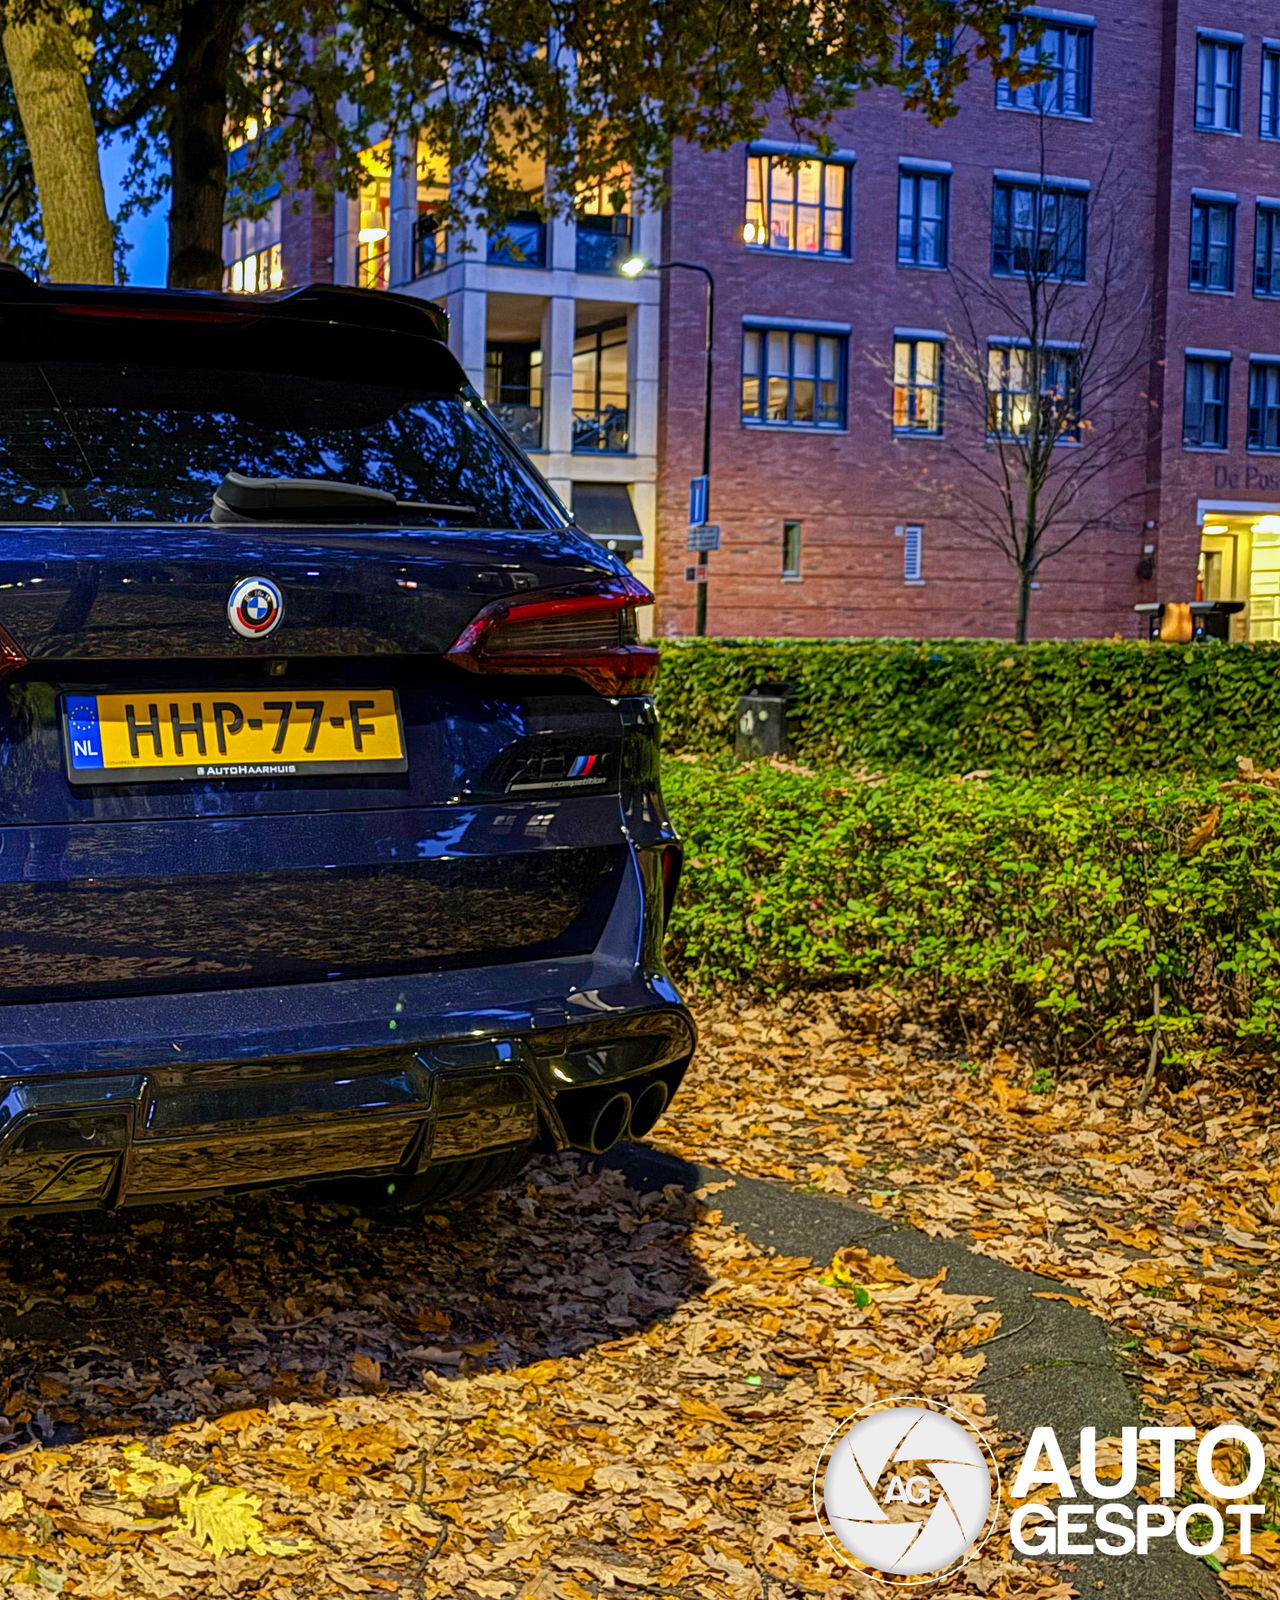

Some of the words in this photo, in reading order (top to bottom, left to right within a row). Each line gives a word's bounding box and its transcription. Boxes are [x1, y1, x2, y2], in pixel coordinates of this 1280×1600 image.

[1214, 465, 1239, 490] De
[125, 700, 376, 758] HHP-77-F
[73, 740, 99, 757] NL
[552, 778, 607, 788] competition
